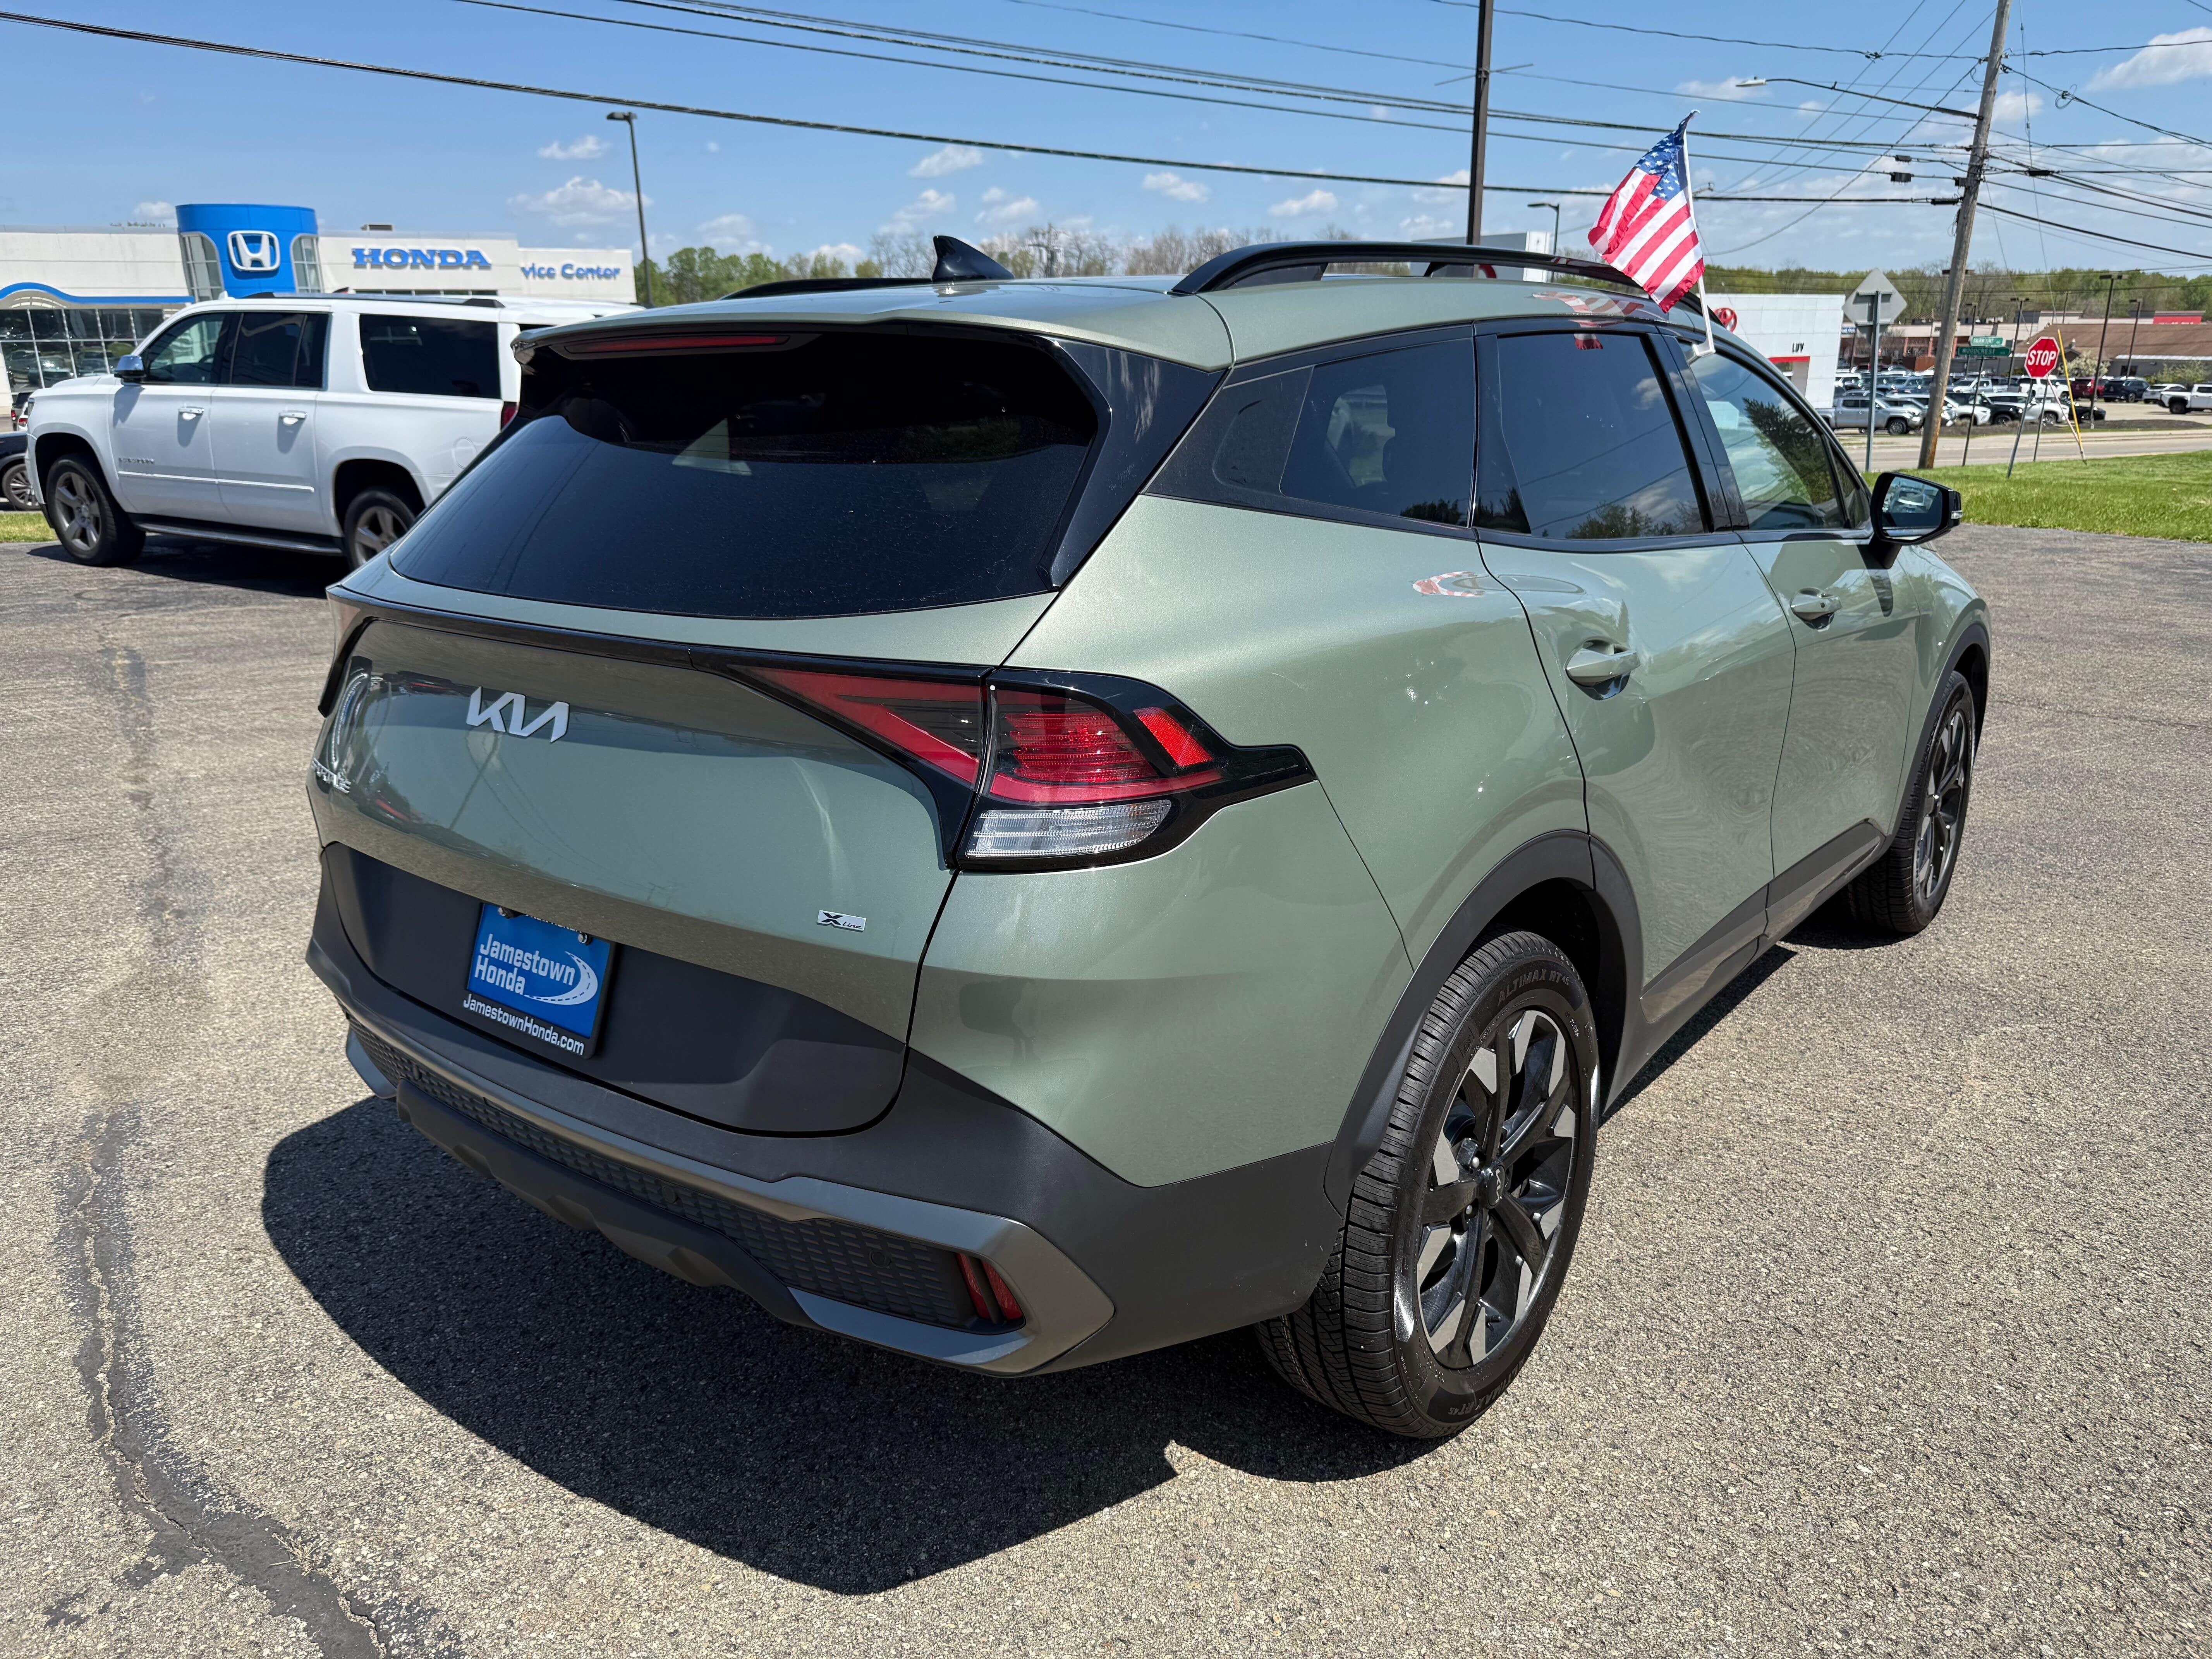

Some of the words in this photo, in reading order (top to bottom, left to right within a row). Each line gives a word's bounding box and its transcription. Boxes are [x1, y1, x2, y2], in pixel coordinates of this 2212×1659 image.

[352, 248, 492, 269] HONDA
[562, 264, 620, 280] Center
[1792, 342, 1804, 353] LUV
[2028, 349, 2056, 366] STOP
[466, 686, 570, 743] KIA
[474, 955, 526, 996] Honda
[479, 933, 575, 986] Jamestown
[1498, 969, 1547, 1006] ALTIMAX
[463, 993, 584, 1056] JamestownHonda.com
